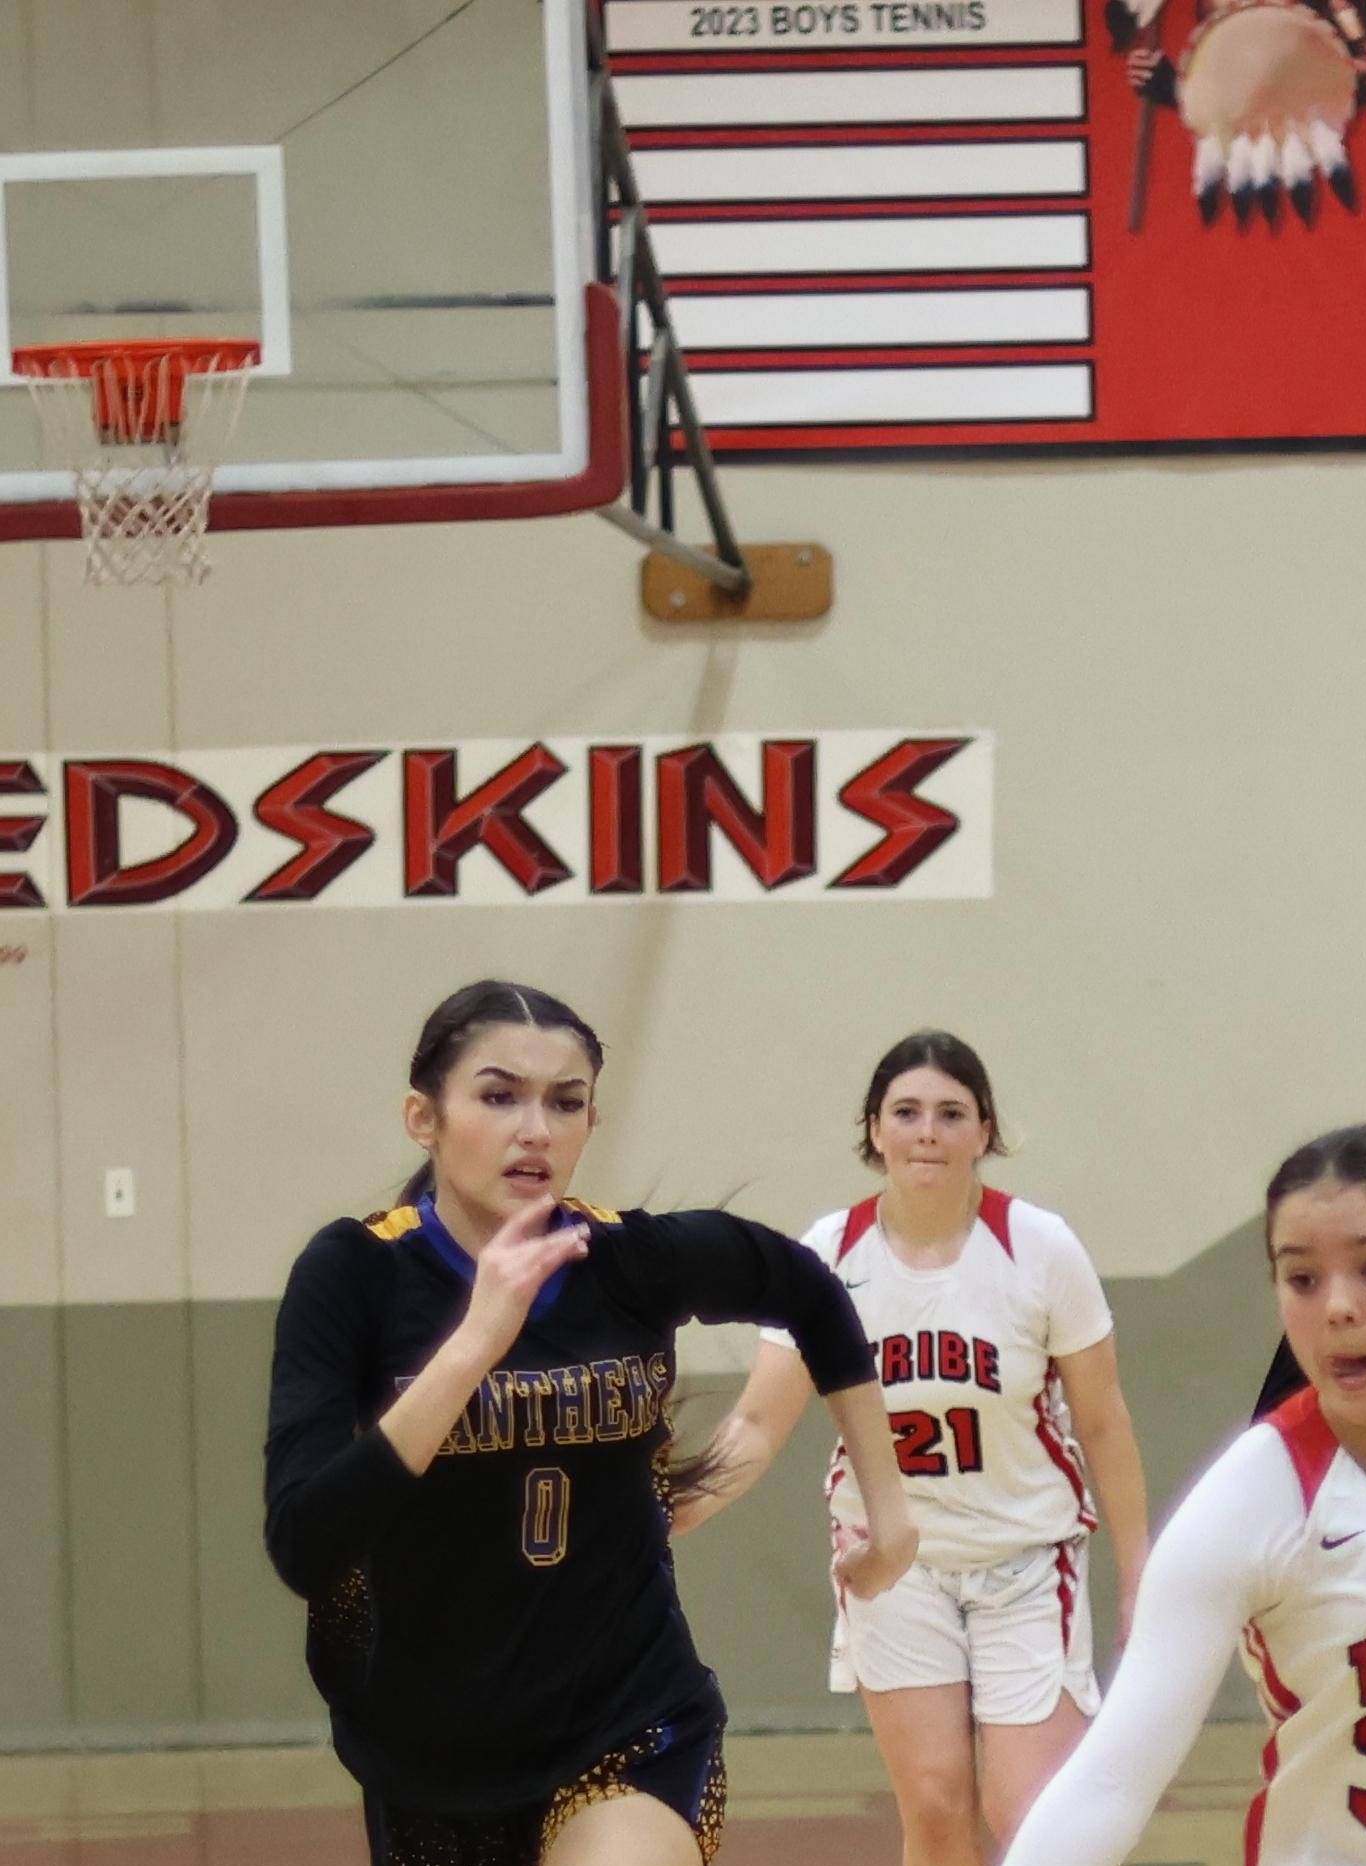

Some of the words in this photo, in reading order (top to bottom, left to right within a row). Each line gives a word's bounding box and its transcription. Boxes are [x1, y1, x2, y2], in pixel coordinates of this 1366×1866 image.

[690, 7, 760, 36] 2023
[771, 5, 859, 34] BOYS
[870, 1, 986, 32] TENNIS
[868, 1329, 1001, 1395] RIBE
[394, 1352, 668, 1455] NTHERS
[887, 1407, 983, 1478] 21
[521, 1466, 570, 1566] 0
